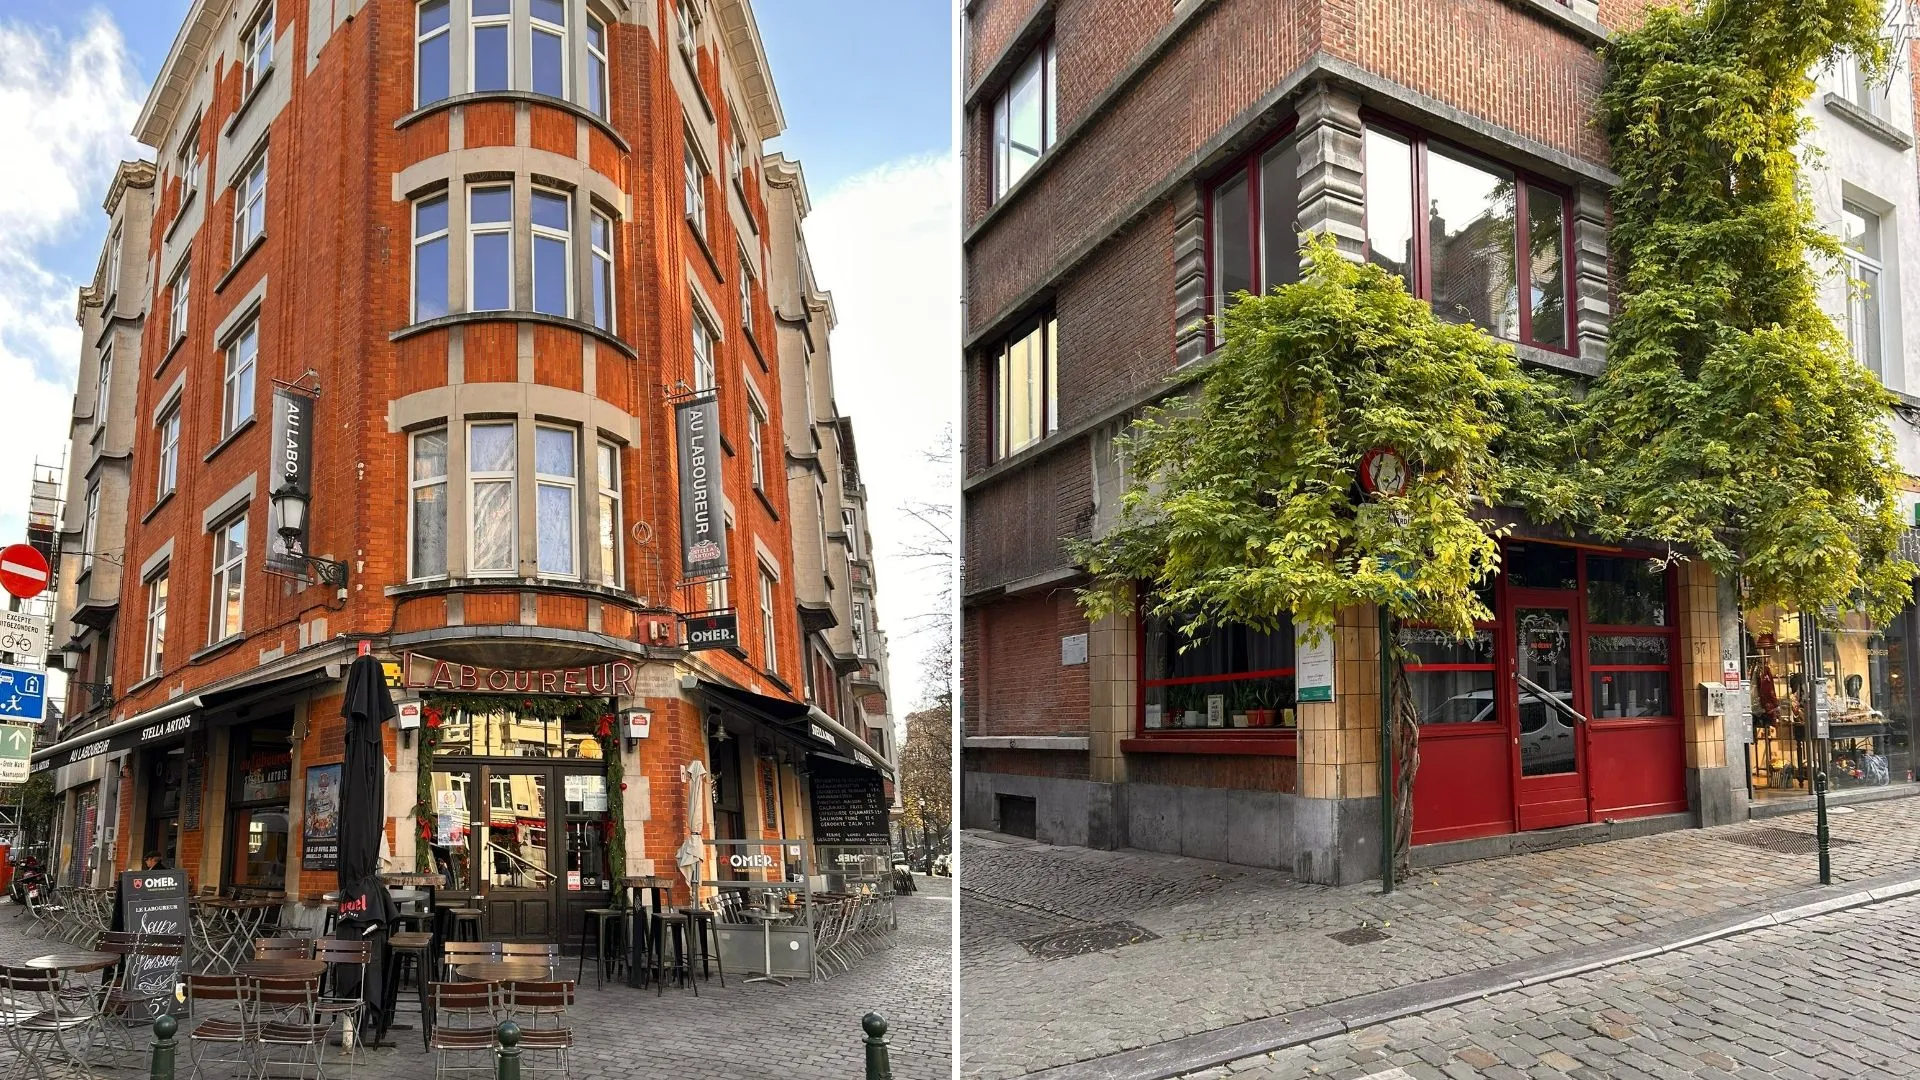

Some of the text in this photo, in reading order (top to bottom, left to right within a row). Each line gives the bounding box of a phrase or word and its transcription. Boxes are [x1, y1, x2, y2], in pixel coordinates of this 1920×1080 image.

[285, 402, 300, 478] AU LABO
[690, 410, 709, 535] AU LABOUREUR
[0, 620, 39, 634] ITGEZONDERD
[691, 628, 735, 643] OMER.
[403, 651, 636, 696] LABOUREUR
[141, 714, 192, 741] STELLA ARTOIS
[68, 739, 111, 763] AU LABOUREUR
[729, 854, 778, 868] OMER.
[144, 876, 178, 888] OMER.
